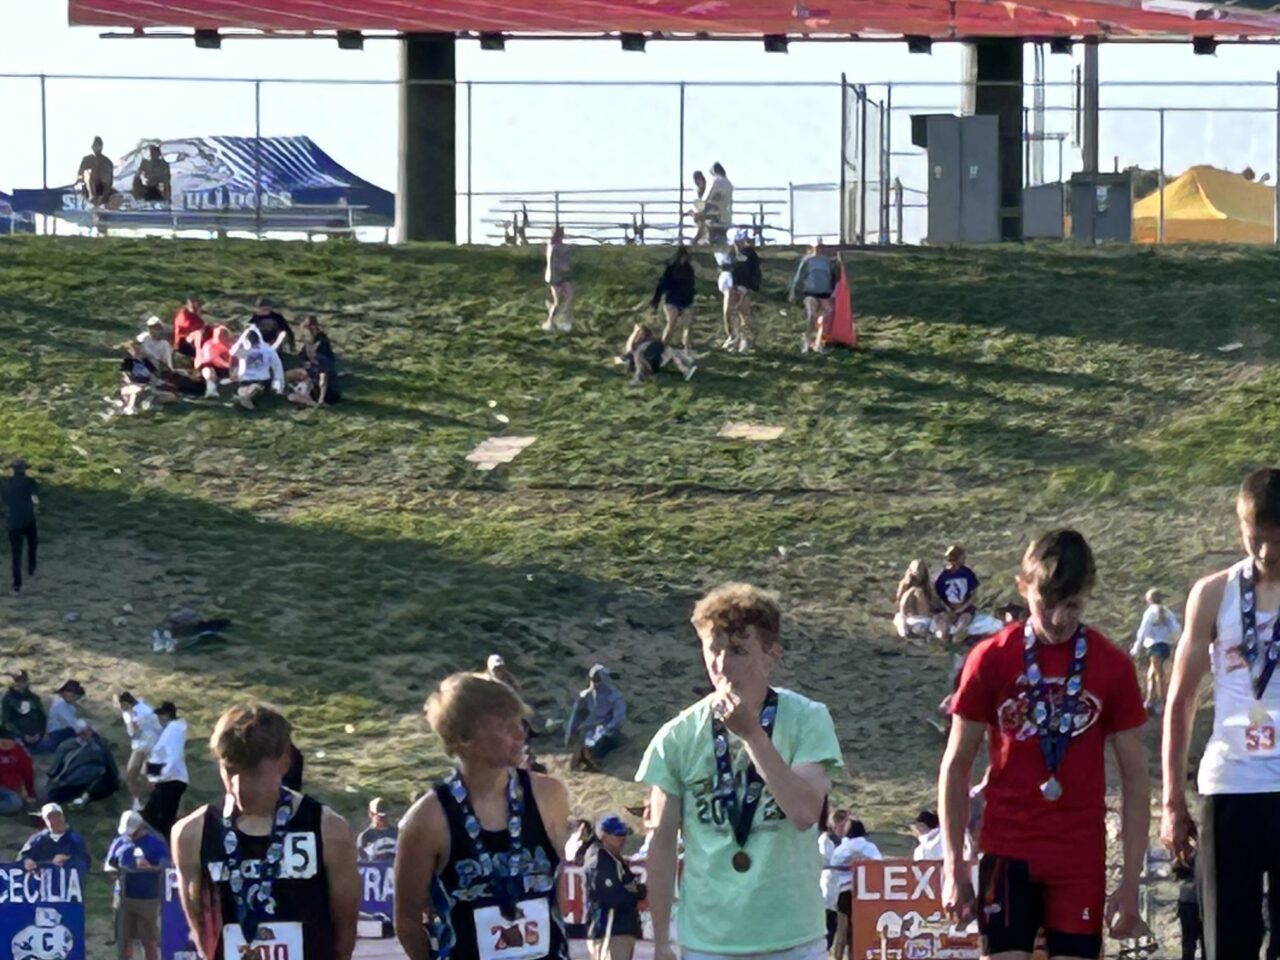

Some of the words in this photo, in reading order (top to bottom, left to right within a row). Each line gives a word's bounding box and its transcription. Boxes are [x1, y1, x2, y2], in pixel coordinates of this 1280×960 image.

[1245, 725, 1275, 751] 53
[292, 836, 309, 873] 5
[857, 865, 944, 900] LEX
